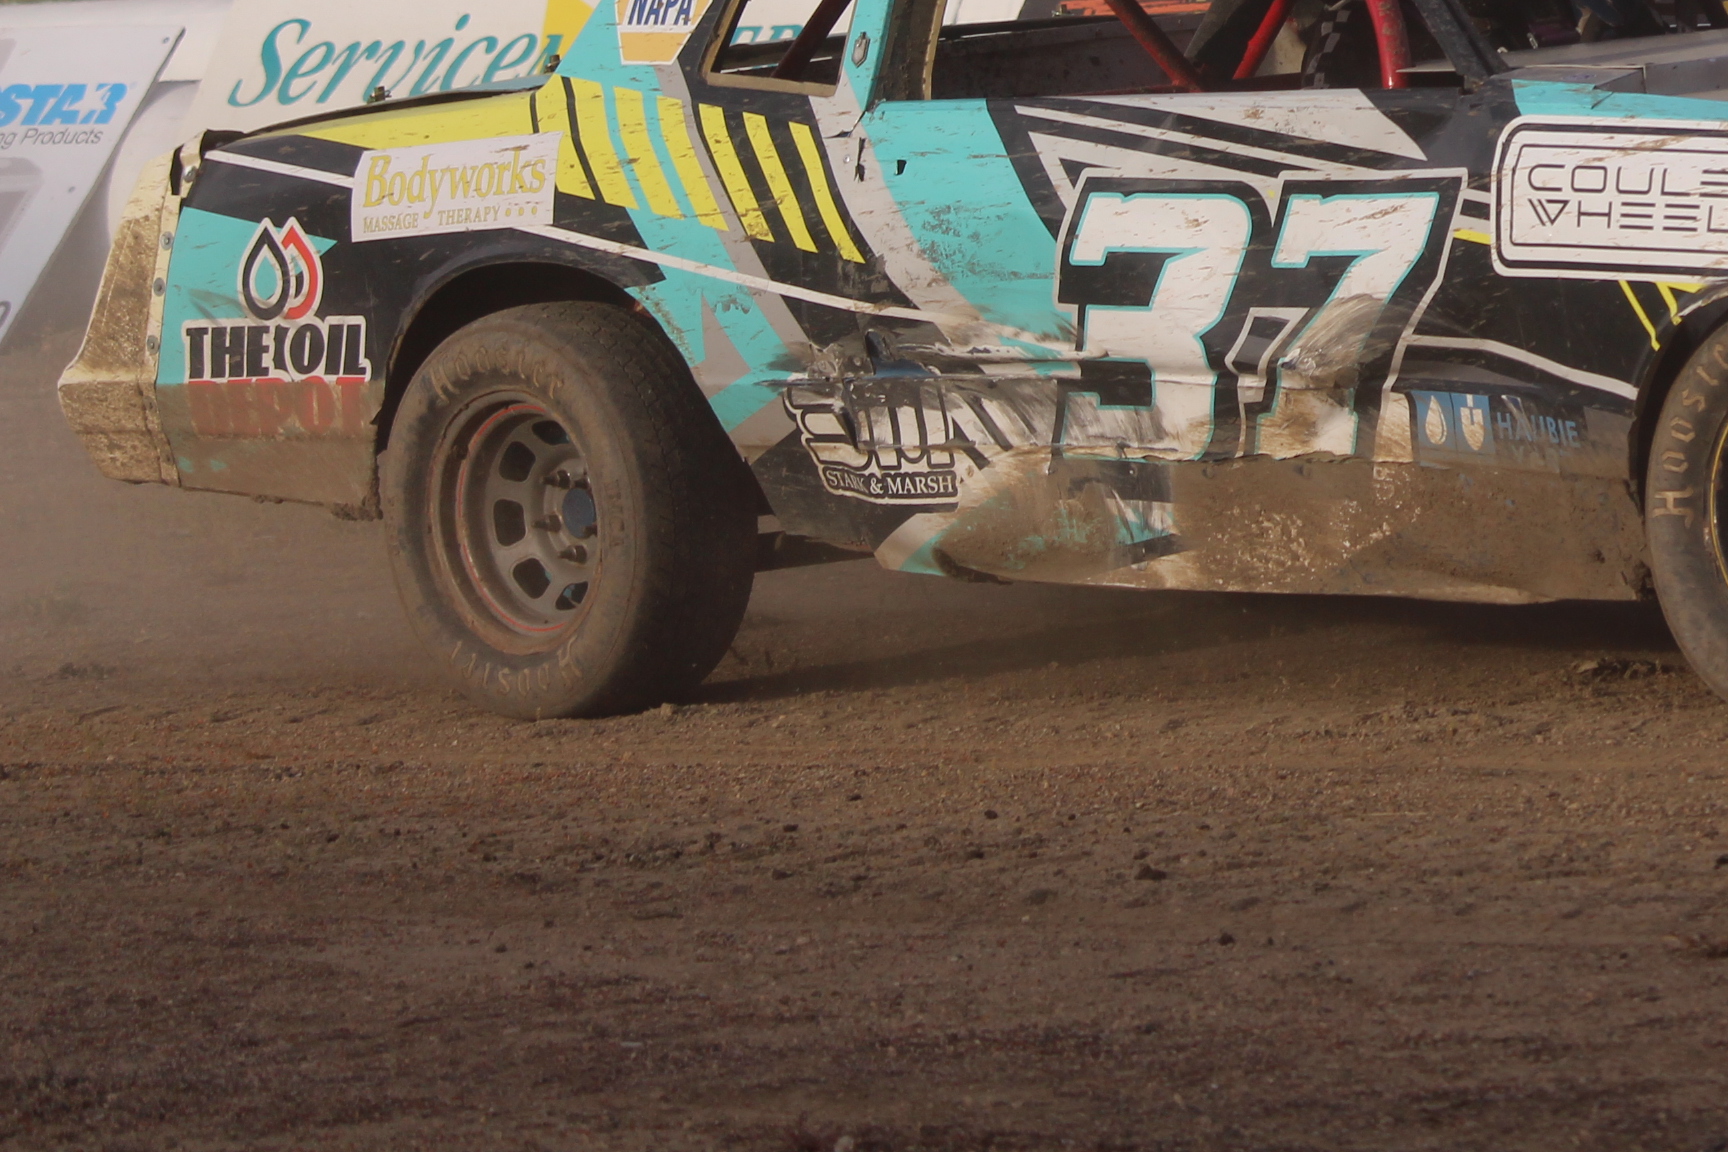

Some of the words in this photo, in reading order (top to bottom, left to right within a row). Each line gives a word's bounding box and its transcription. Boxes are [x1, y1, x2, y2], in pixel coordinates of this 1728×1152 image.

[21, 127, 104, 146] Products
[361, 146, 547, 220] Bodyworks
[362, 212, 419, 234] MASSAGE
[437, 205, 501, 227] THERAPY
[185, 323, 271, 379] THE
[289, 322, 367, 378] OIL
[1063, 191, 1440, 463] 37
[186, 376, 368, 436] DEPOT
[825, 469, 868, 494] STARK
[869, 477, 884, 495] &
[886, 474, 954, 495] MARSH
